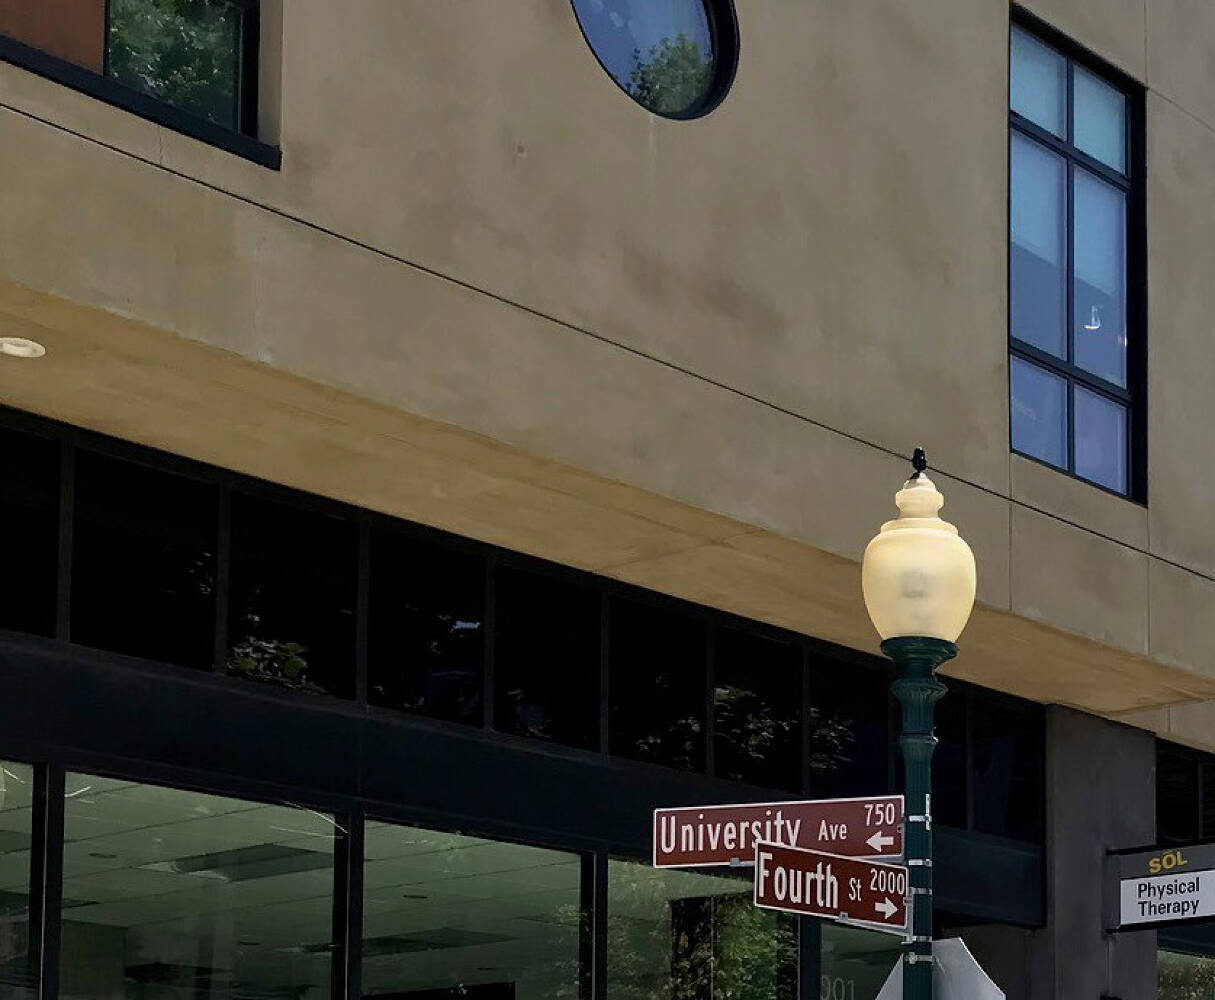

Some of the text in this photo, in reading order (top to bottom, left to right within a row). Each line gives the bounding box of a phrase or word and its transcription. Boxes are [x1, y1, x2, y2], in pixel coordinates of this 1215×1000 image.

[864, 803, 895, 827] 750
[661, 810, 847, 853] University Ave
[758, 852, 861, 909] Fourth St
[870, 868, 905, 895] 2000
[1137, 877, 1200, 899] Physical
[1138, 900, 1200, 916] Therapy
